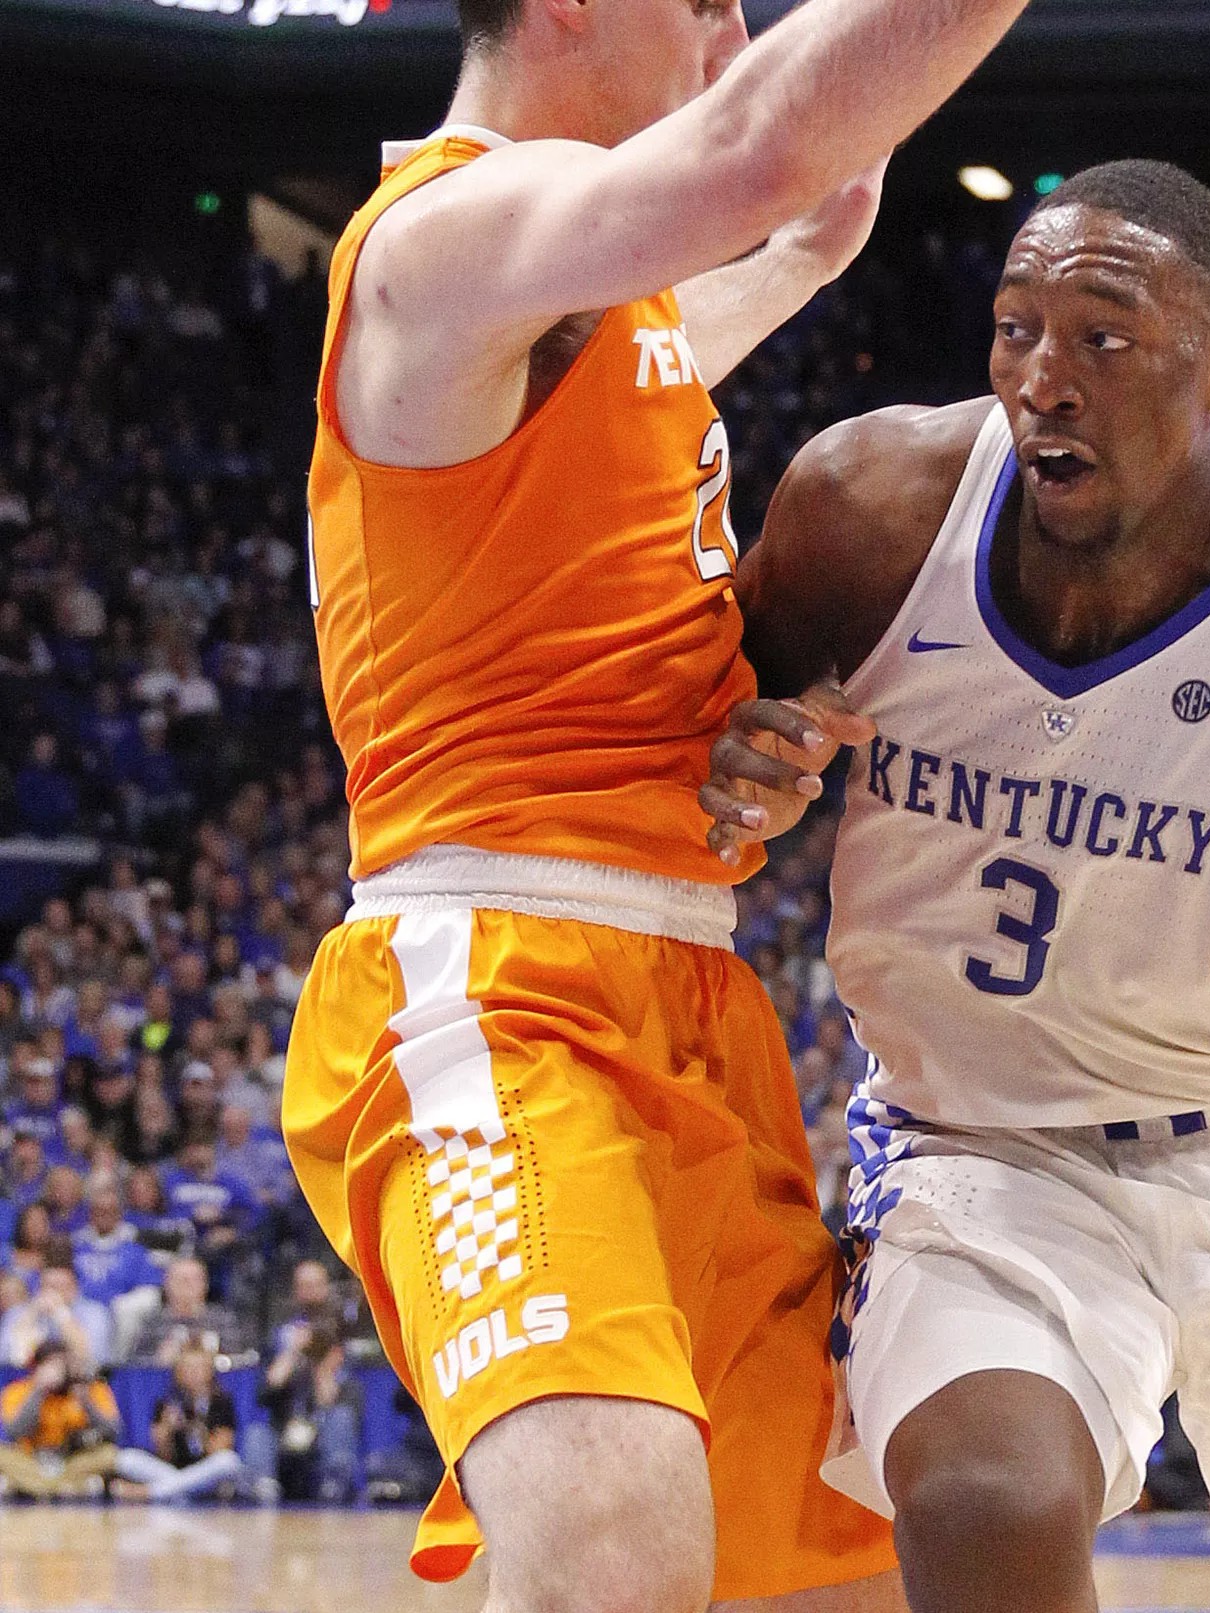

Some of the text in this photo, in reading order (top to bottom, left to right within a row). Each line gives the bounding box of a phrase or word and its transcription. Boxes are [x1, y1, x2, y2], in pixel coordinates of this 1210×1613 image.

[691, 416, 739, 582] 2
[964, 856, 1061, 996] 3
[432, 1293, 570, 1399] VOLS
